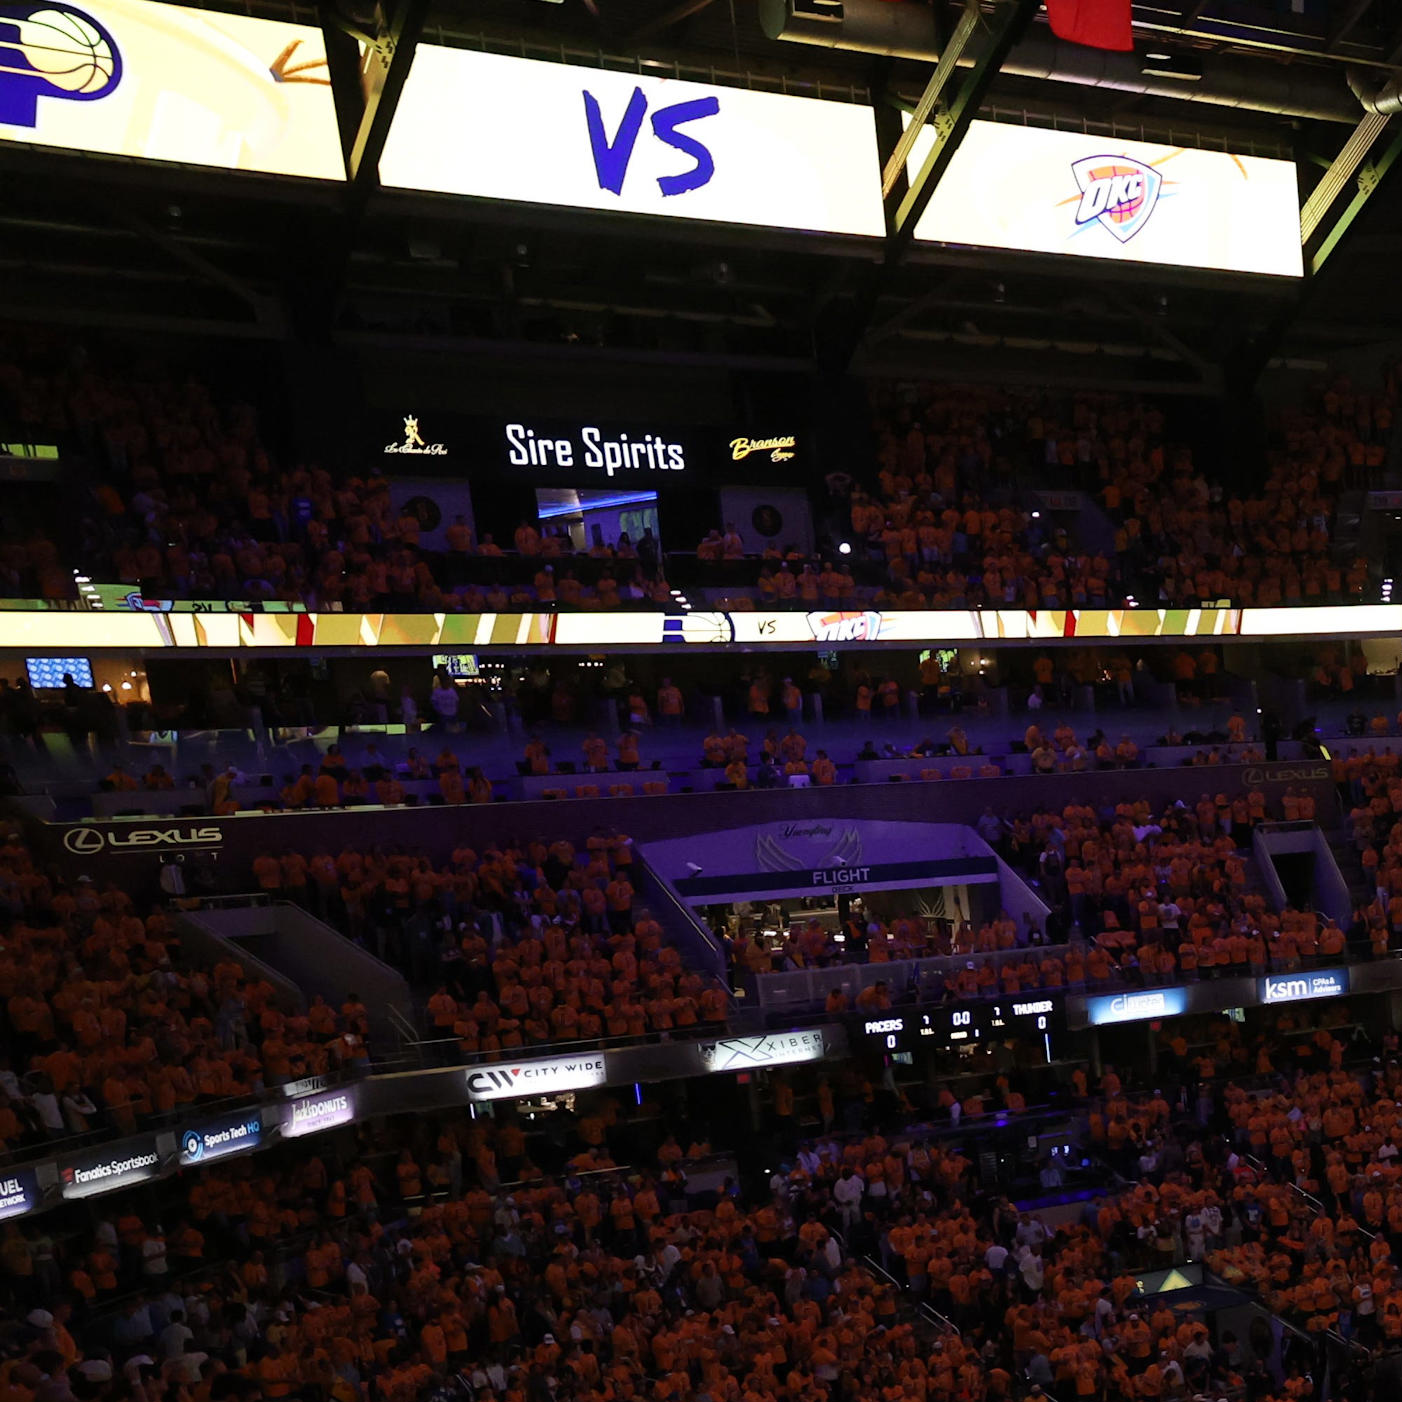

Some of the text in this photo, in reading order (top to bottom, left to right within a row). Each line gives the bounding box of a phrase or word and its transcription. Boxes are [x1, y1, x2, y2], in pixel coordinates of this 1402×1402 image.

[582, 87, 720, 197] VS
[1076, 173, 1144, 225] OKC
[506, 423, 684, 477] Sire Spirits
[729, 436, 796, 461] Branson
[757, 619, 776, 635] VS
[1266, 767, 1329, 781] LEXUS
[108, 827, 223, 848] LEXUS
[812, 867, 870, 885] FLIGHT
[1265, 978, 1308, 999] ksm
[1012, 1000, 1053, 1016] THUNDER
[865, 1019, 903, 1034] PACERS
[1038, 1016, 1047, 1029] 0
[767, 1033, 821, 1051] XIBER
[886, 1035, 896, 1049] 0
[524, 1066, 558, 1078] CITY
[564, 1061, 603, 1073] WIDE
[312, 1095, 347, 1117] DONUTS
[204, 1121, 260, 1147] Sports Tech HQ
[75, 1153, 159, 1183] Fanatics Sportsbook
[0, 1178, 23, 1196] UEL
